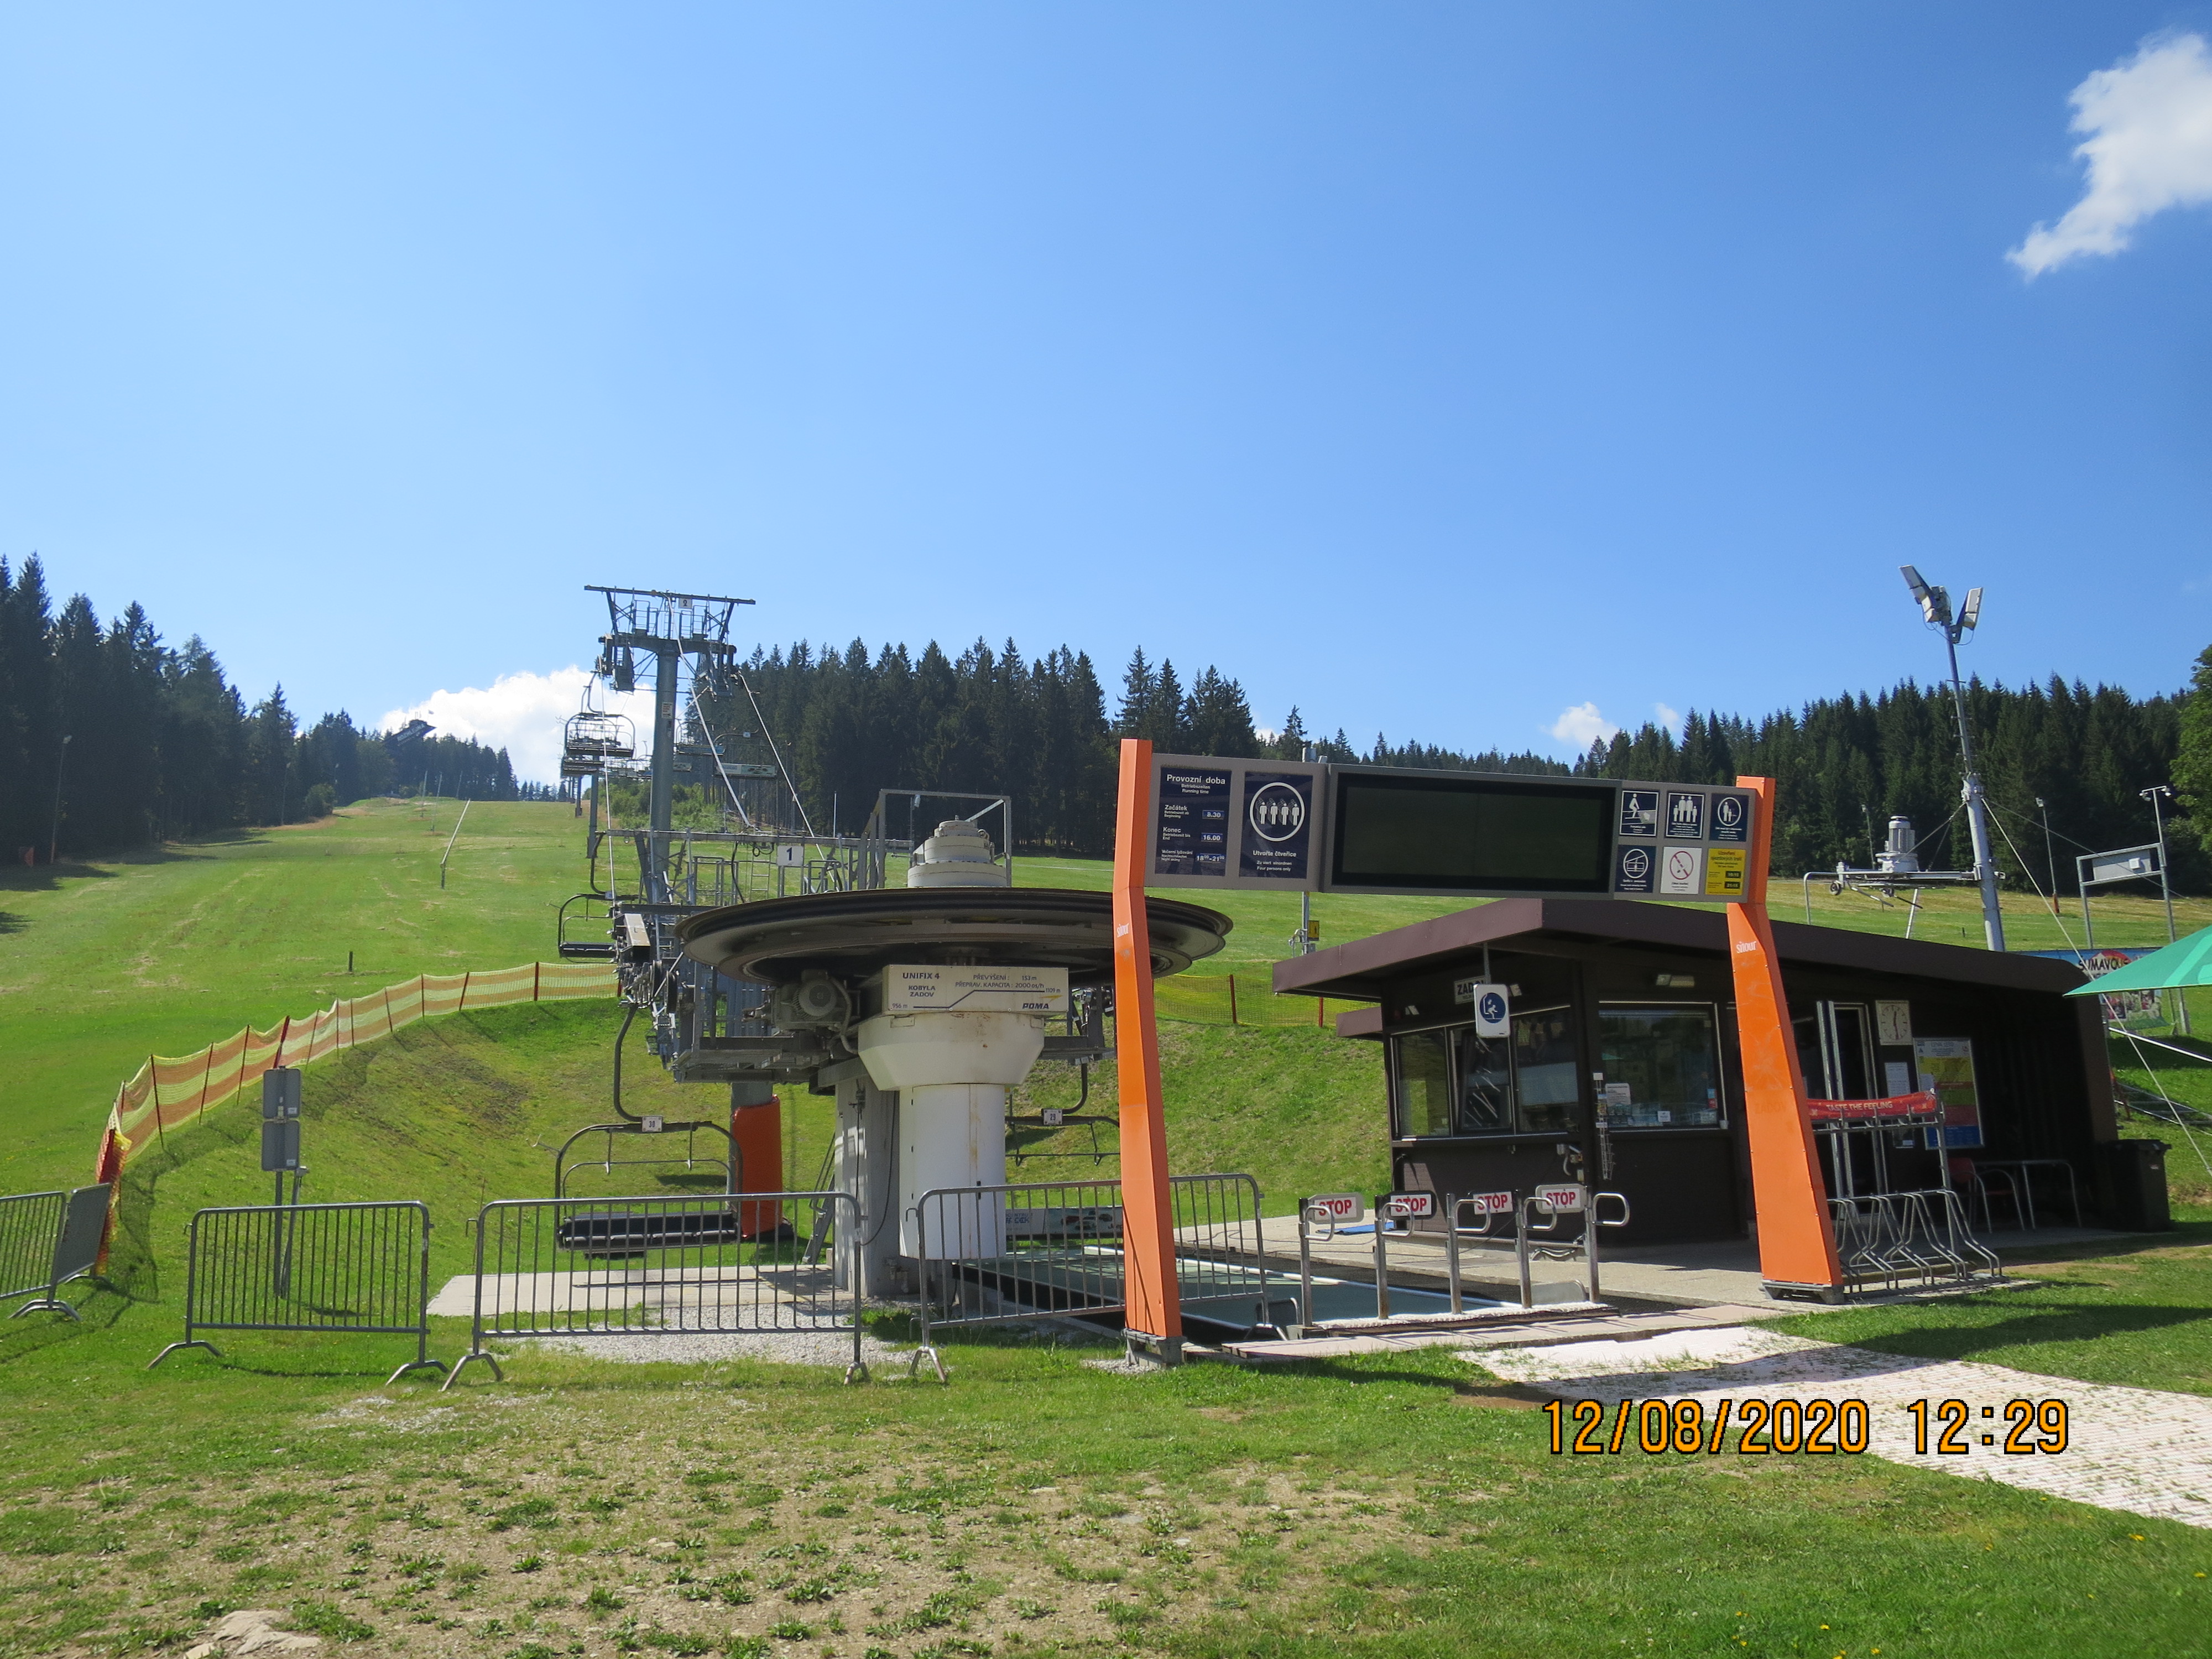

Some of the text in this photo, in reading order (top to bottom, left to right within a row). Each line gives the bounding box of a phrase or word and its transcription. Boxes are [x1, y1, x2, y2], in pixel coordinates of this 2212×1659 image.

[1167, 774, 1202, 783] Provozní
[786, 847, 792, 861] 1
[1736, 941, 1757, 953] sitour
[1864, 1102, 1893, 1110] FEELING
[1395, 1198, 1427, 1212] STOP
[1478, 1194, 1508, 1210] STOP
[1546, 1192, 1575, 1205] STOP
[1319, 1199, 1352, 1216] STOP
